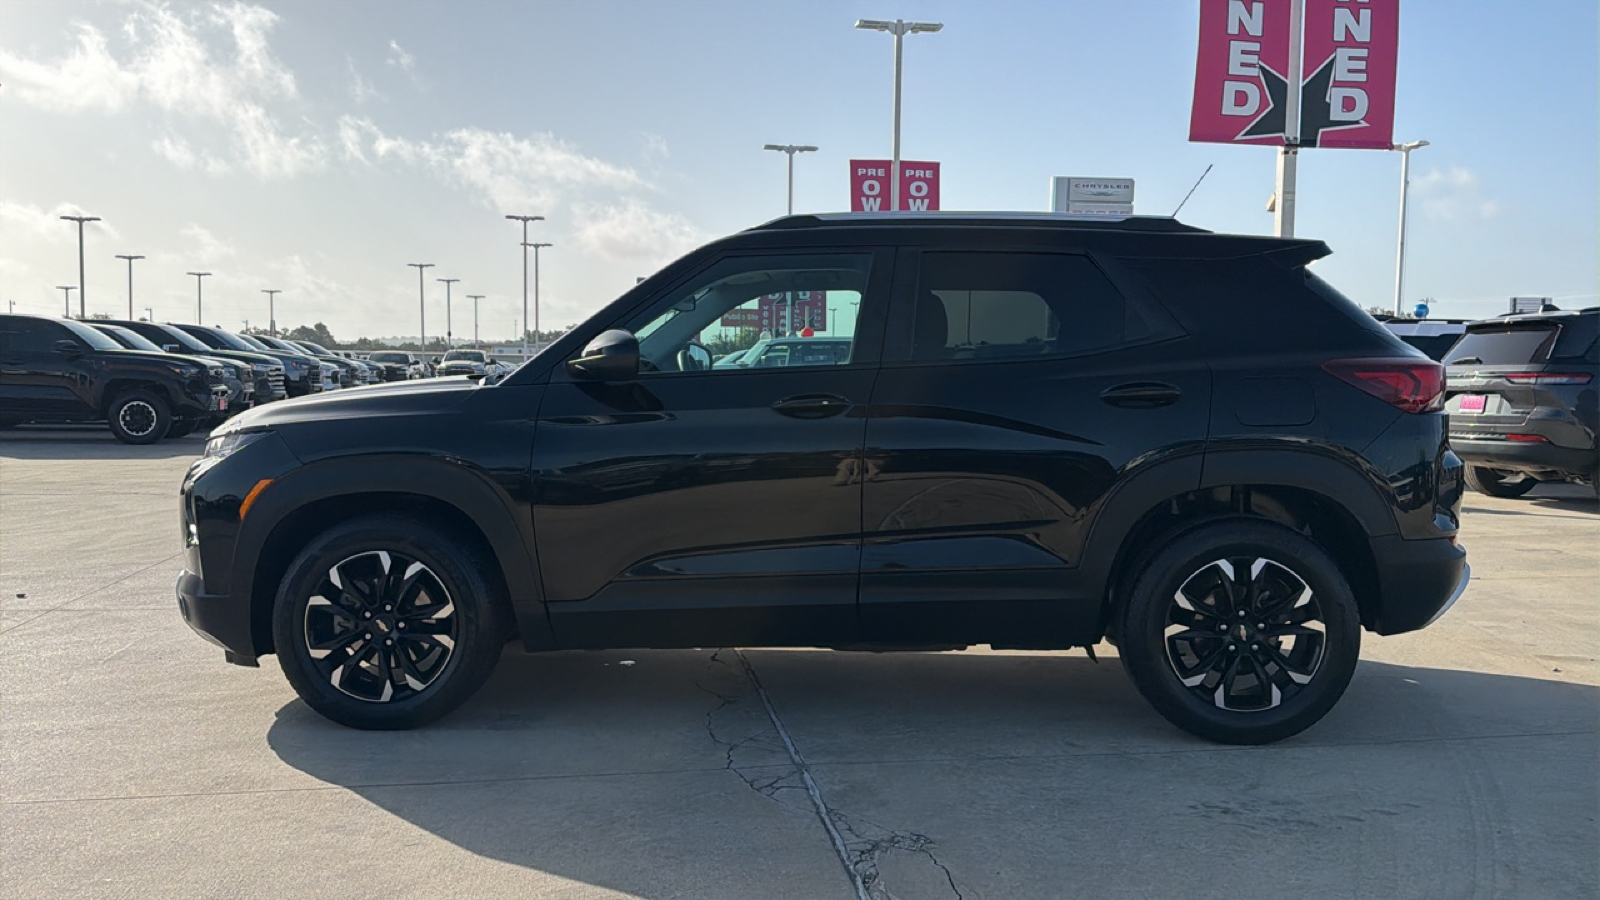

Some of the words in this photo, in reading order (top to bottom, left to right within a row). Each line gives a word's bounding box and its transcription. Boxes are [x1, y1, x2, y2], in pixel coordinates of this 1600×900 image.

[1329, 0, 1372, 121] NED
[857, 168, 885, 176] PRE
[905, 169, 933, 178] PRE
